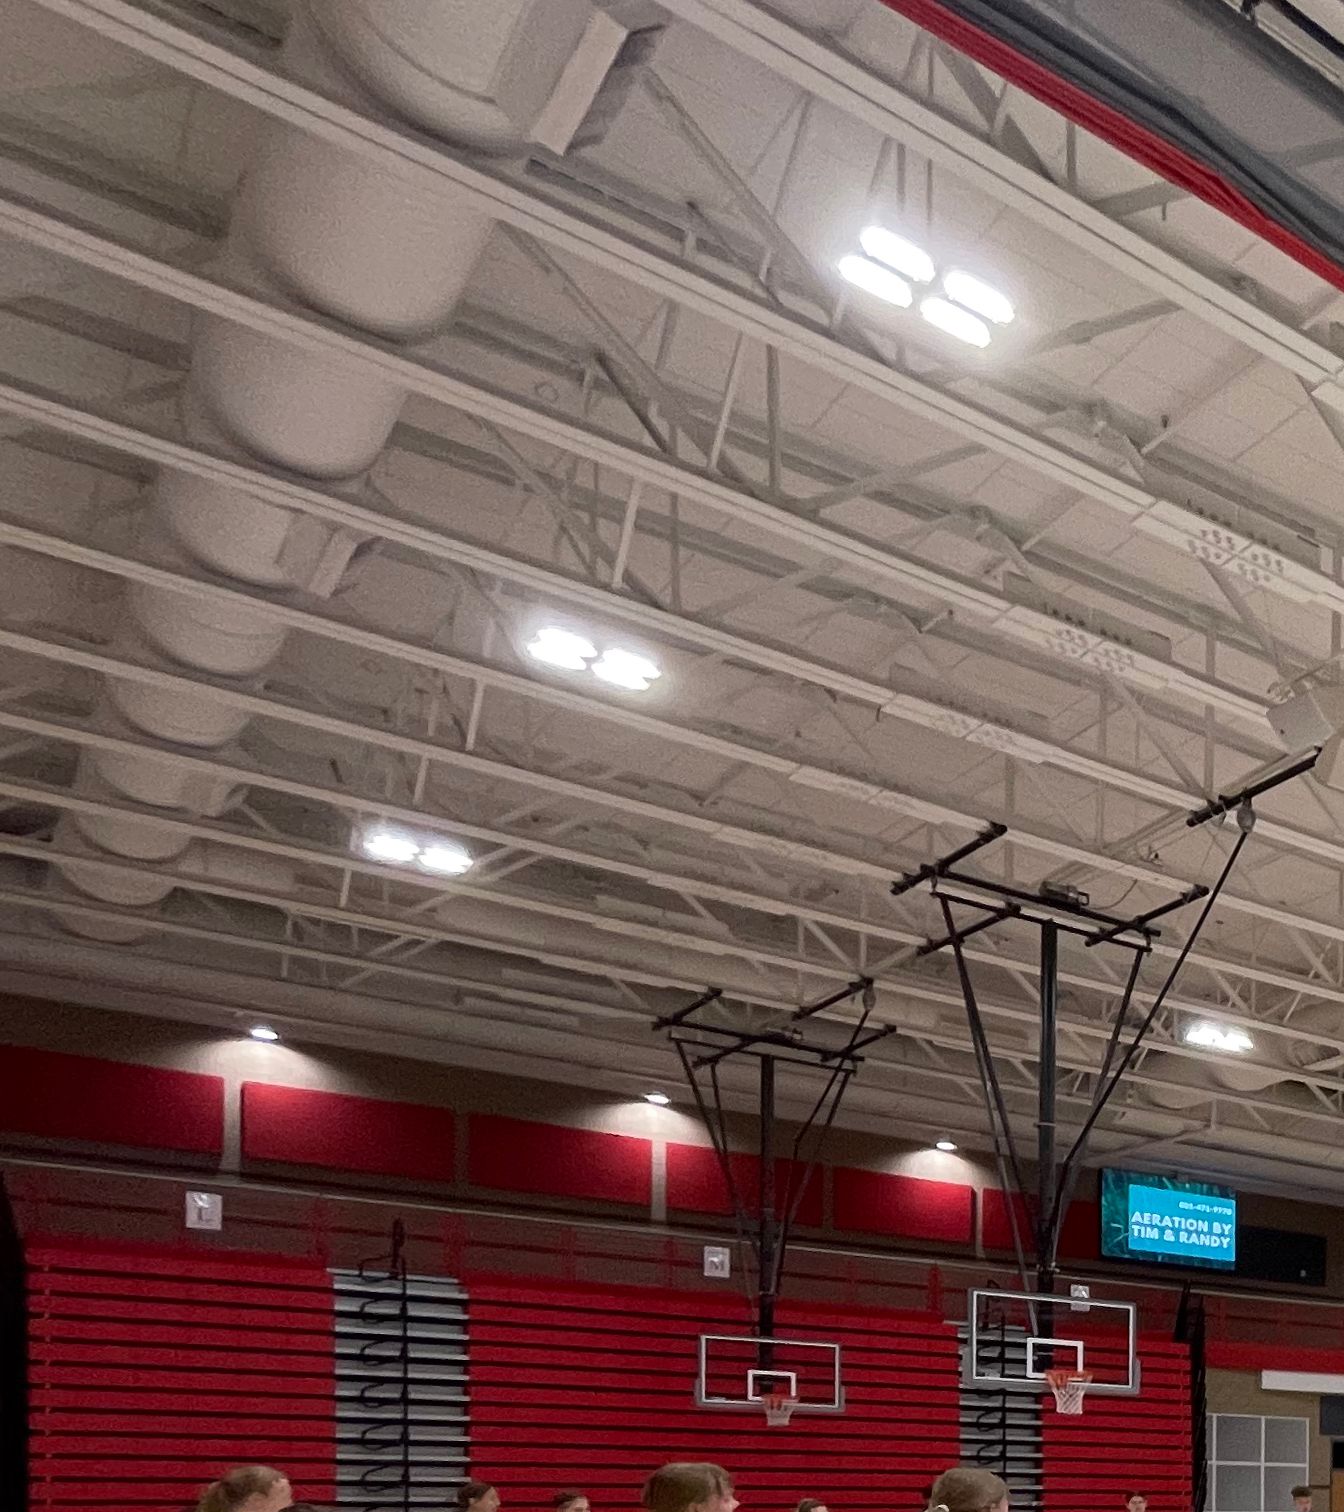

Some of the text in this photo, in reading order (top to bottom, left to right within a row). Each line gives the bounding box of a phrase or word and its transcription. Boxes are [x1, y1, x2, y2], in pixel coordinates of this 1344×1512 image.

[1131, 1211, 1232, 1235] AERATION BY
[1131, 1225, 1230, 1248] TIM & RANDY
